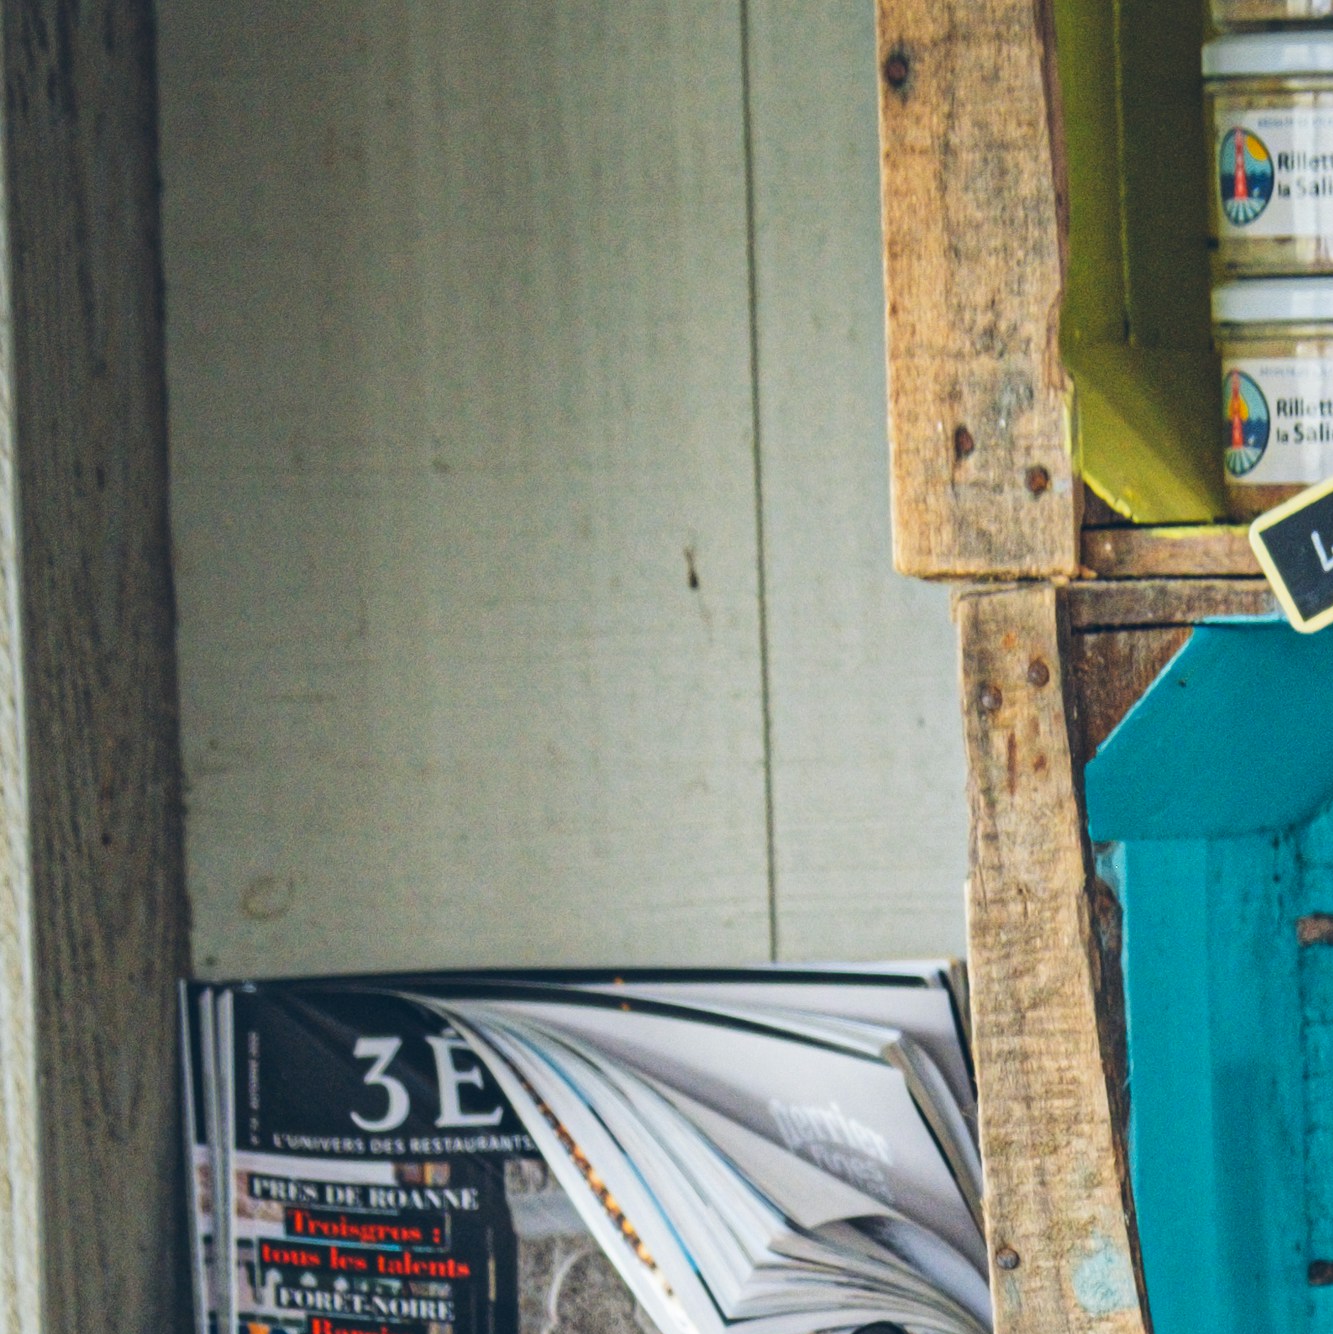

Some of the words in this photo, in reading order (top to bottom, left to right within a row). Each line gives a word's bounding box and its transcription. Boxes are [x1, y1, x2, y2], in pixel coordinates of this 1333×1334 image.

[273, 1132, 366, 1154] L'UNIVERS
[370, 1136, 405, 1155] DES
[325, 1184, 363, 1206] DE
[369, 1185, 479, 1212] ROANNE
[287, 1208, 423, 1244] Troisgros
[261, 1243, 321, 1266] tous
[329, 1245, 368, 1271] les
[377, 1250, 471, 1279] talents
